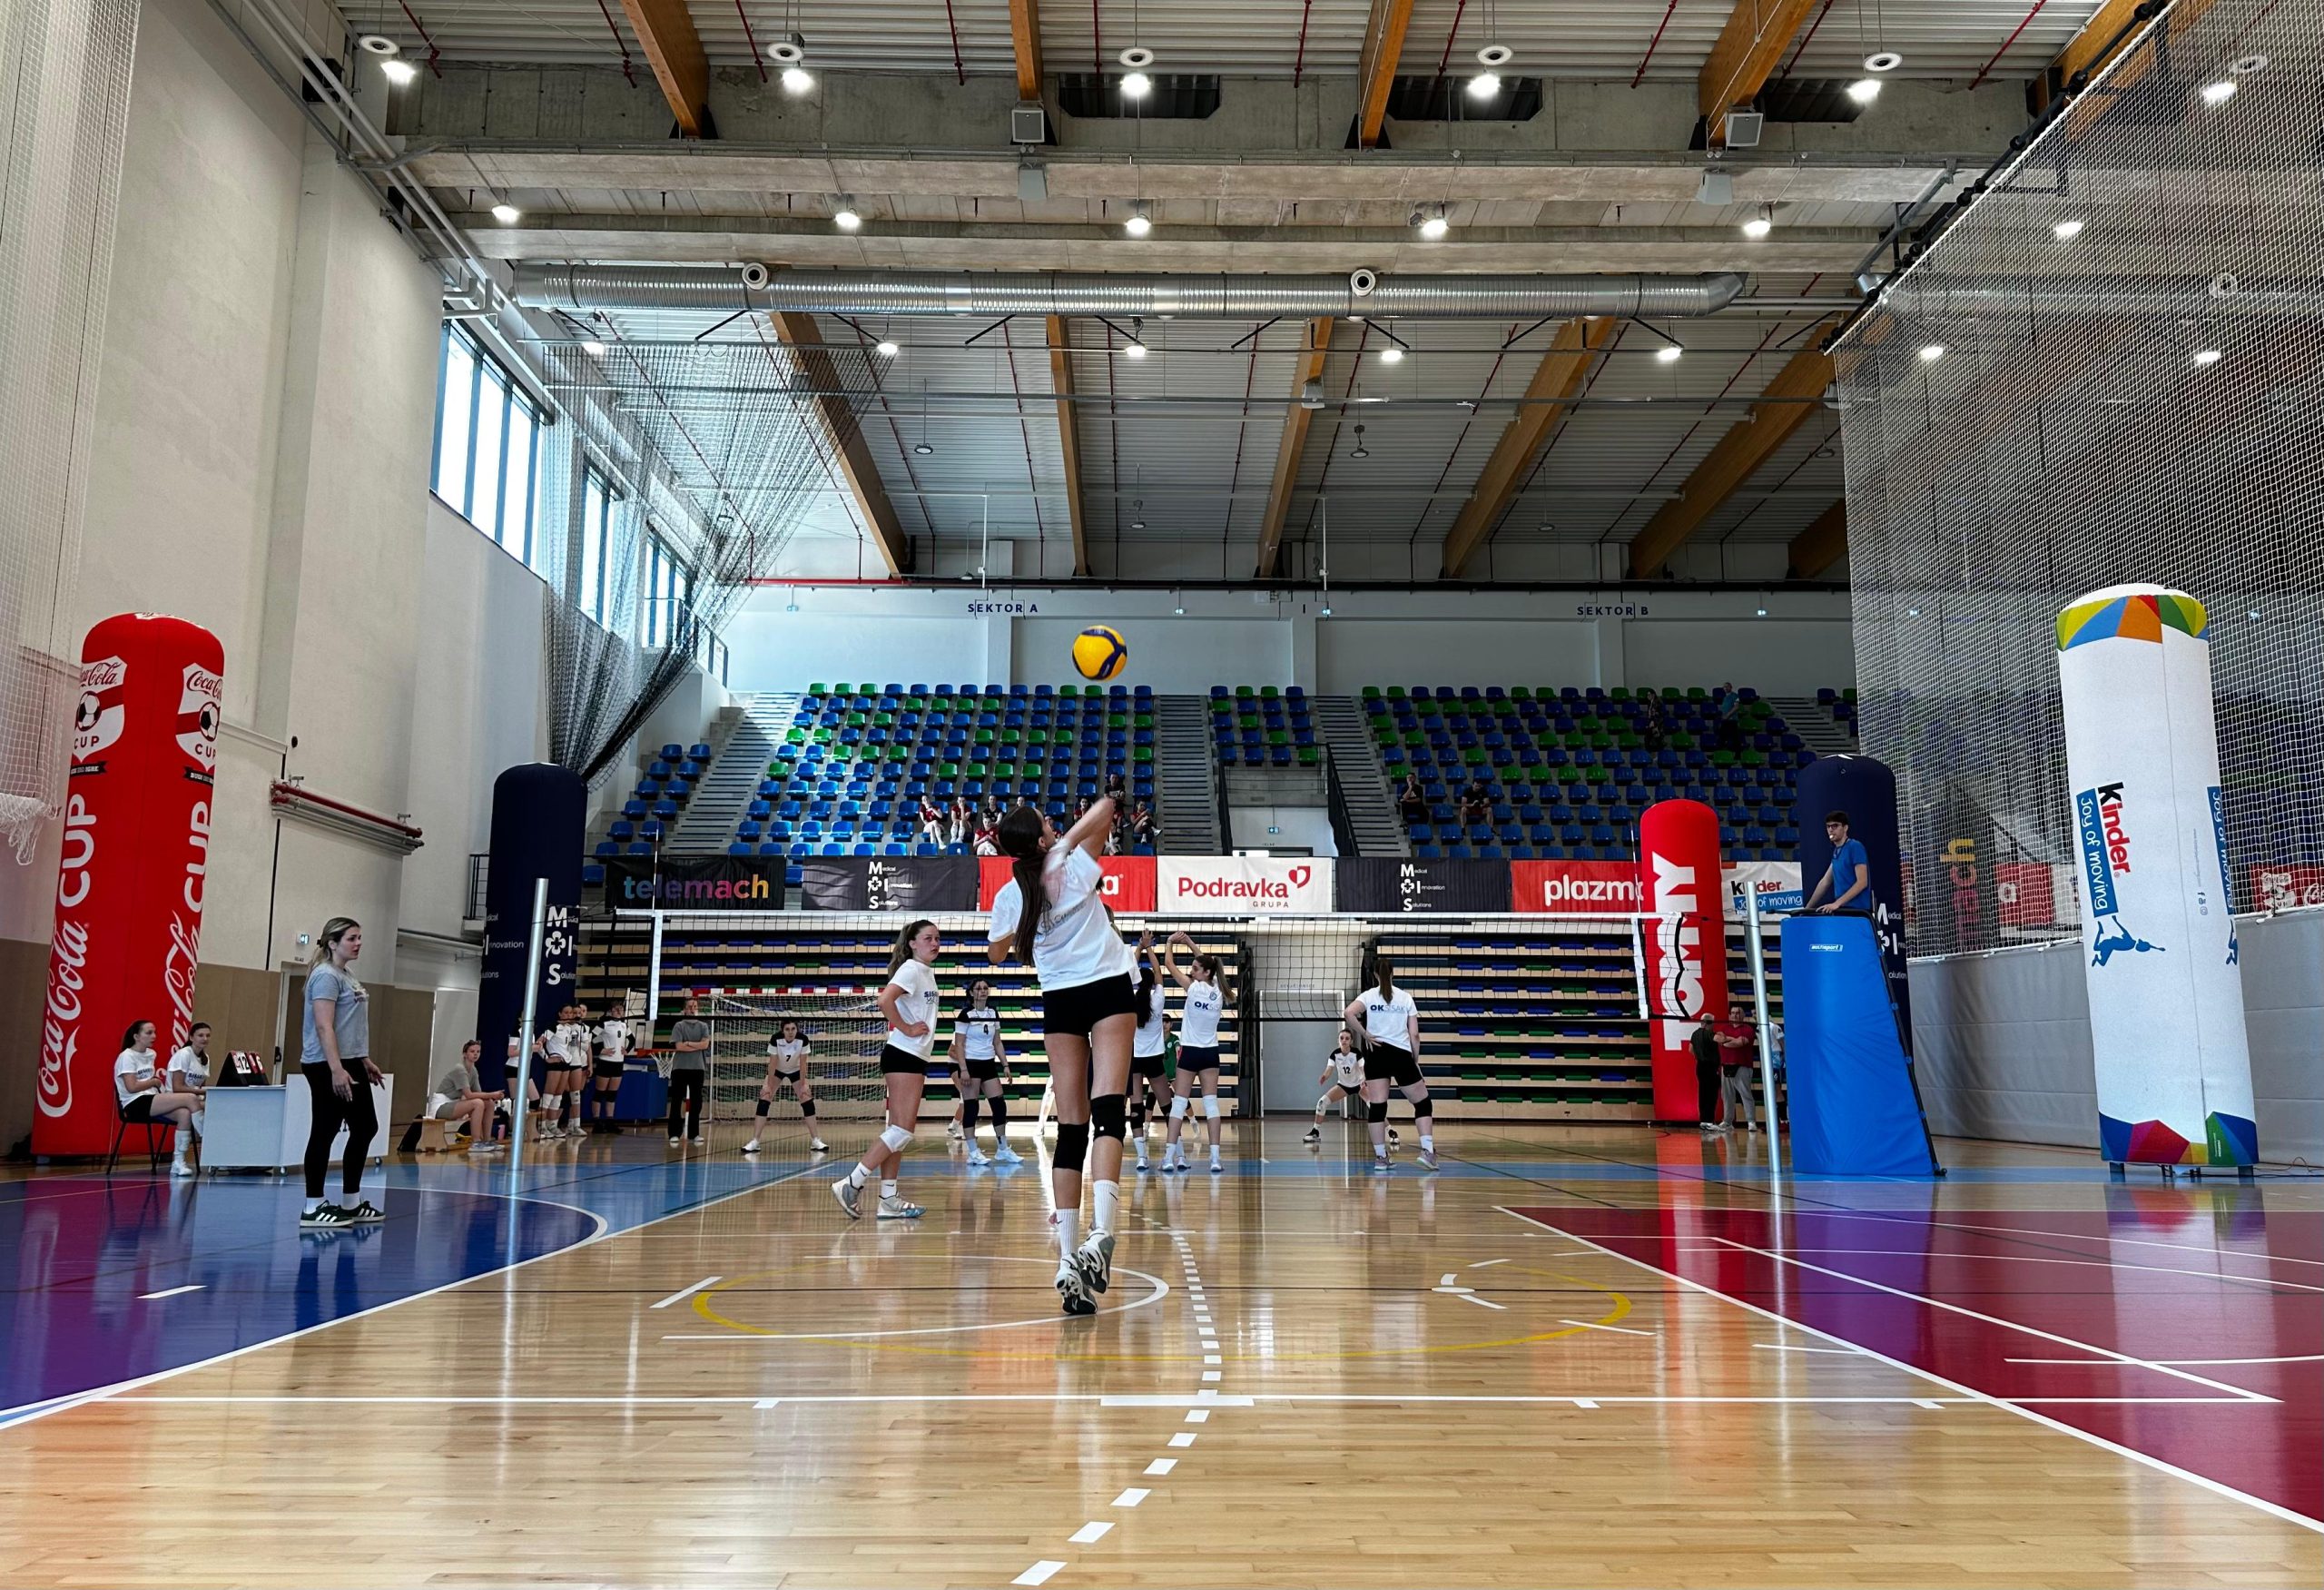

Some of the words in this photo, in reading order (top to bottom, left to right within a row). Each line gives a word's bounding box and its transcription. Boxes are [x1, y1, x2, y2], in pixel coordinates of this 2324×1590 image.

[968, 603, 1023, 613] SEKTOR
[1029, 603, 1038, 613] A
[1577, 606, 1633, 616] SEKTOR
[1640, 606, 1649, 616] B
[80, 662, 122, 687] ca-Cola
[2081, 797, 2093, 827] Joy
[2212, 792, 2221, 823] Joy
[2085, 831, 2101, 847] of
[60, 793, 97, 908] CUP
[184, 801, 211, 914] CUP
[623, 874, 770, 899] telemach
[1178, 877, 1289, 898] Podravka
[2088, 850, 2109, 910] moving
[1253, 900, 1289, 908] GRUPA
[1758, 896, 1767, 907] of
[1769, 893, 1803, 907] moving
[1194, 1001, 1209, 1011] OK
[237, 1056, 250, 1071] 12
[785, 1054, 792, 1062] 7
[1342, 1066, 1352, 1075] 12
